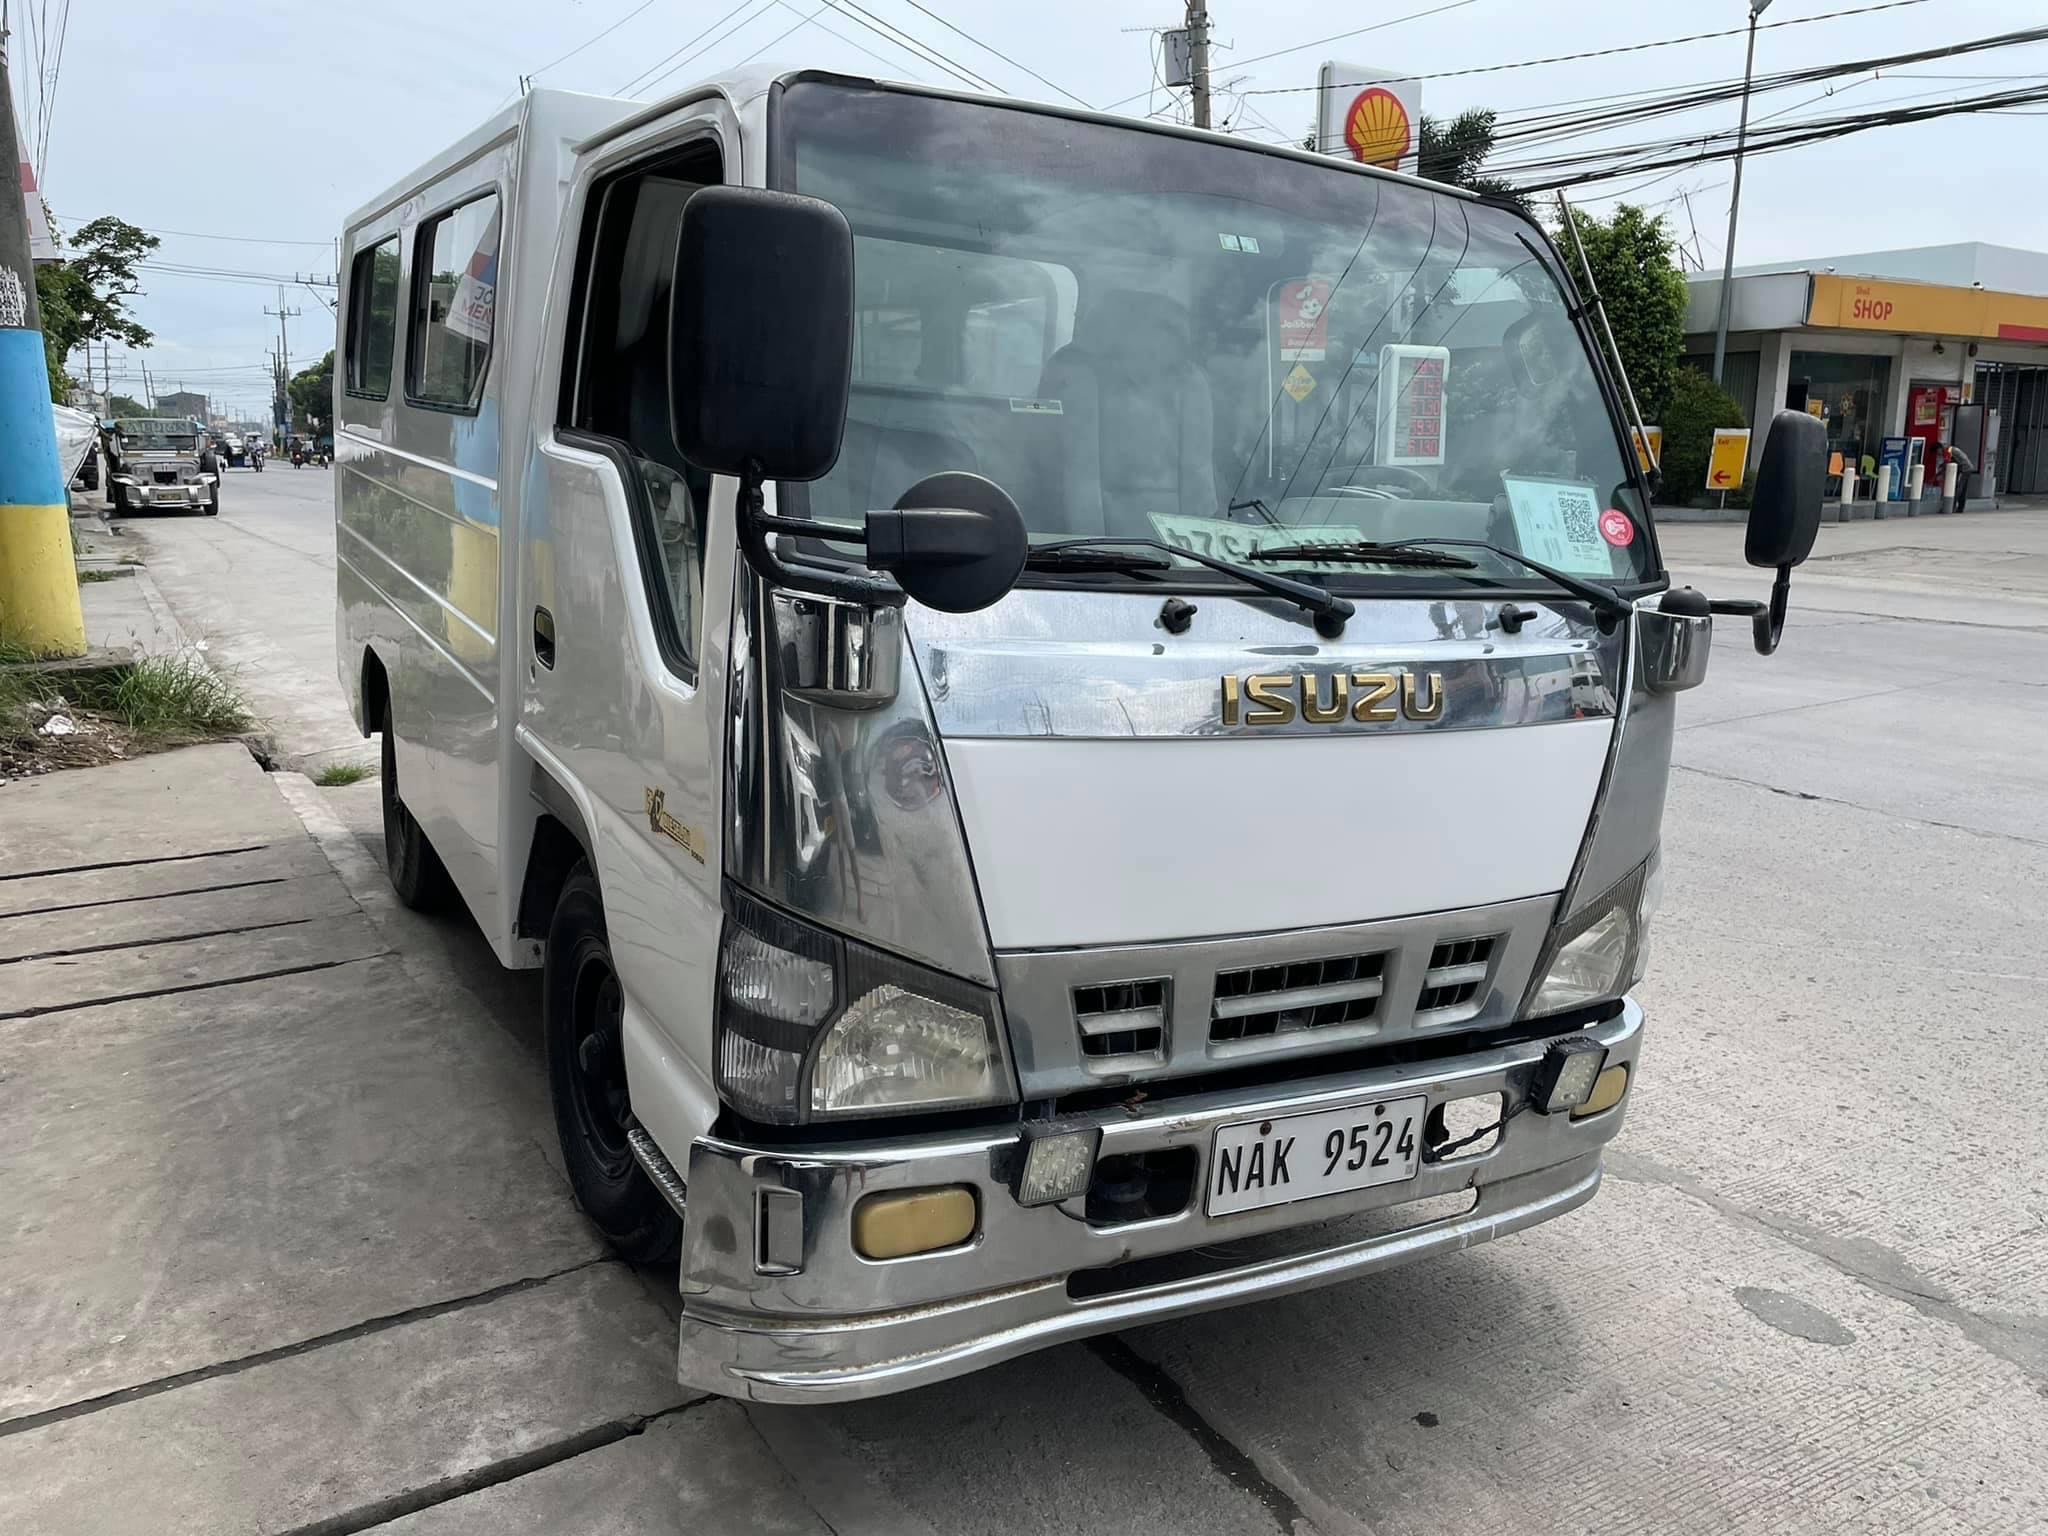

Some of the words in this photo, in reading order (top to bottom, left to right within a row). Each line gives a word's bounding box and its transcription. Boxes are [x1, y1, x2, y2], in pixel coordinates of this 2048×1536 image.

[1853, 299, 1893, 320] SHOP
[1222, 673, 1444, 726] ISUZU
[1218, 1137, 1296, 1196] NAK
[1323, 1117, 1414, 1177] 9524
